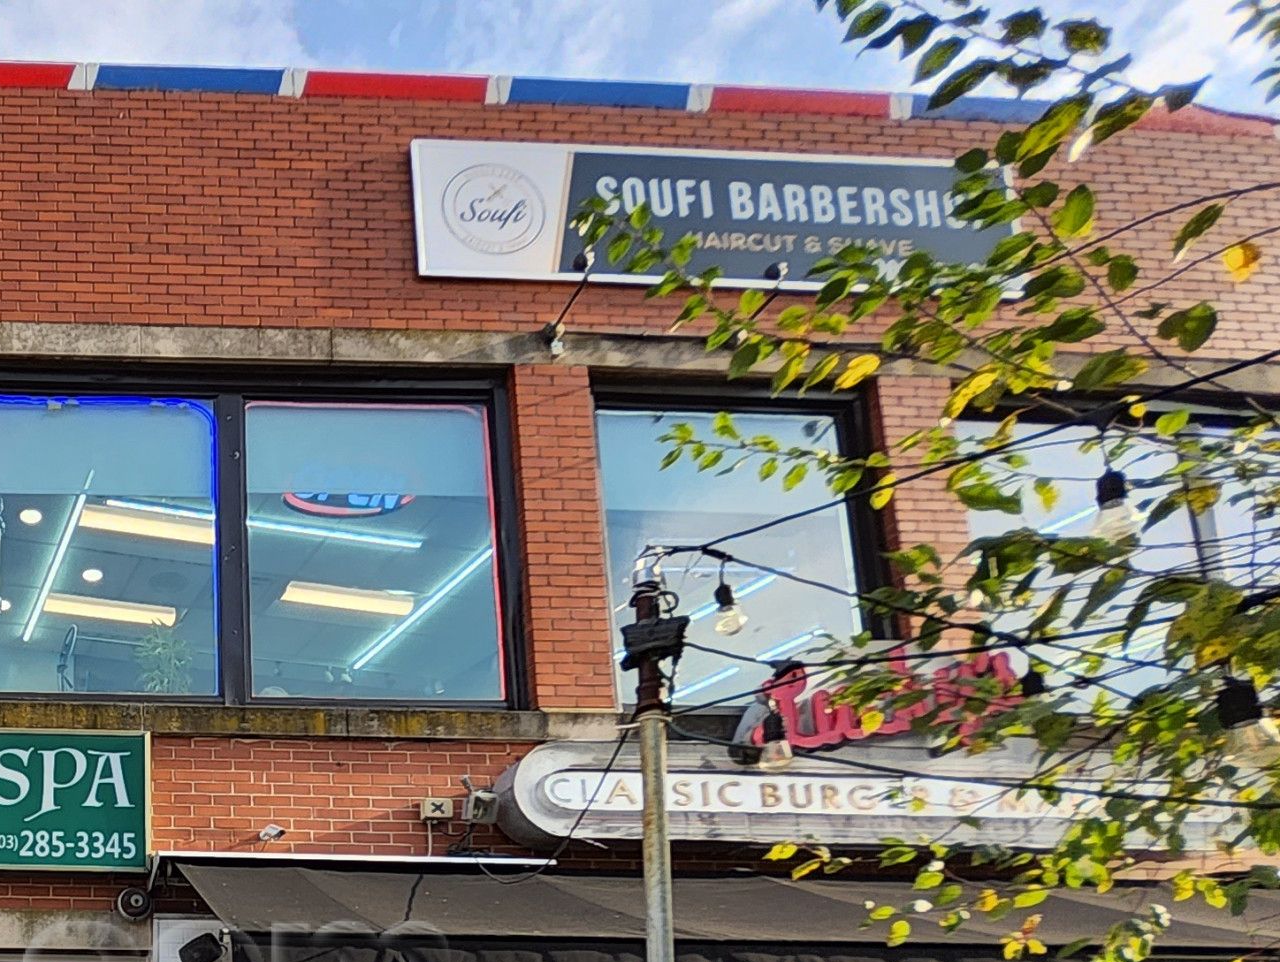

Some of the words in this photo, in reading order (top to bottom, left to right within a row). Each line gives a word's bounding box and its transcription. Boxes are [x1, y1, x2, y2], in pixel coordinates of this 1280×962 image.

[460, 199, 526, 230] Soufi
[596, 176, 713, 219] SOUFI
[729, 181, 984, 230] BARBERSHO
[549, 778, 742, 808] CLASIC
[19, 829, 136, 859] 285-3345
